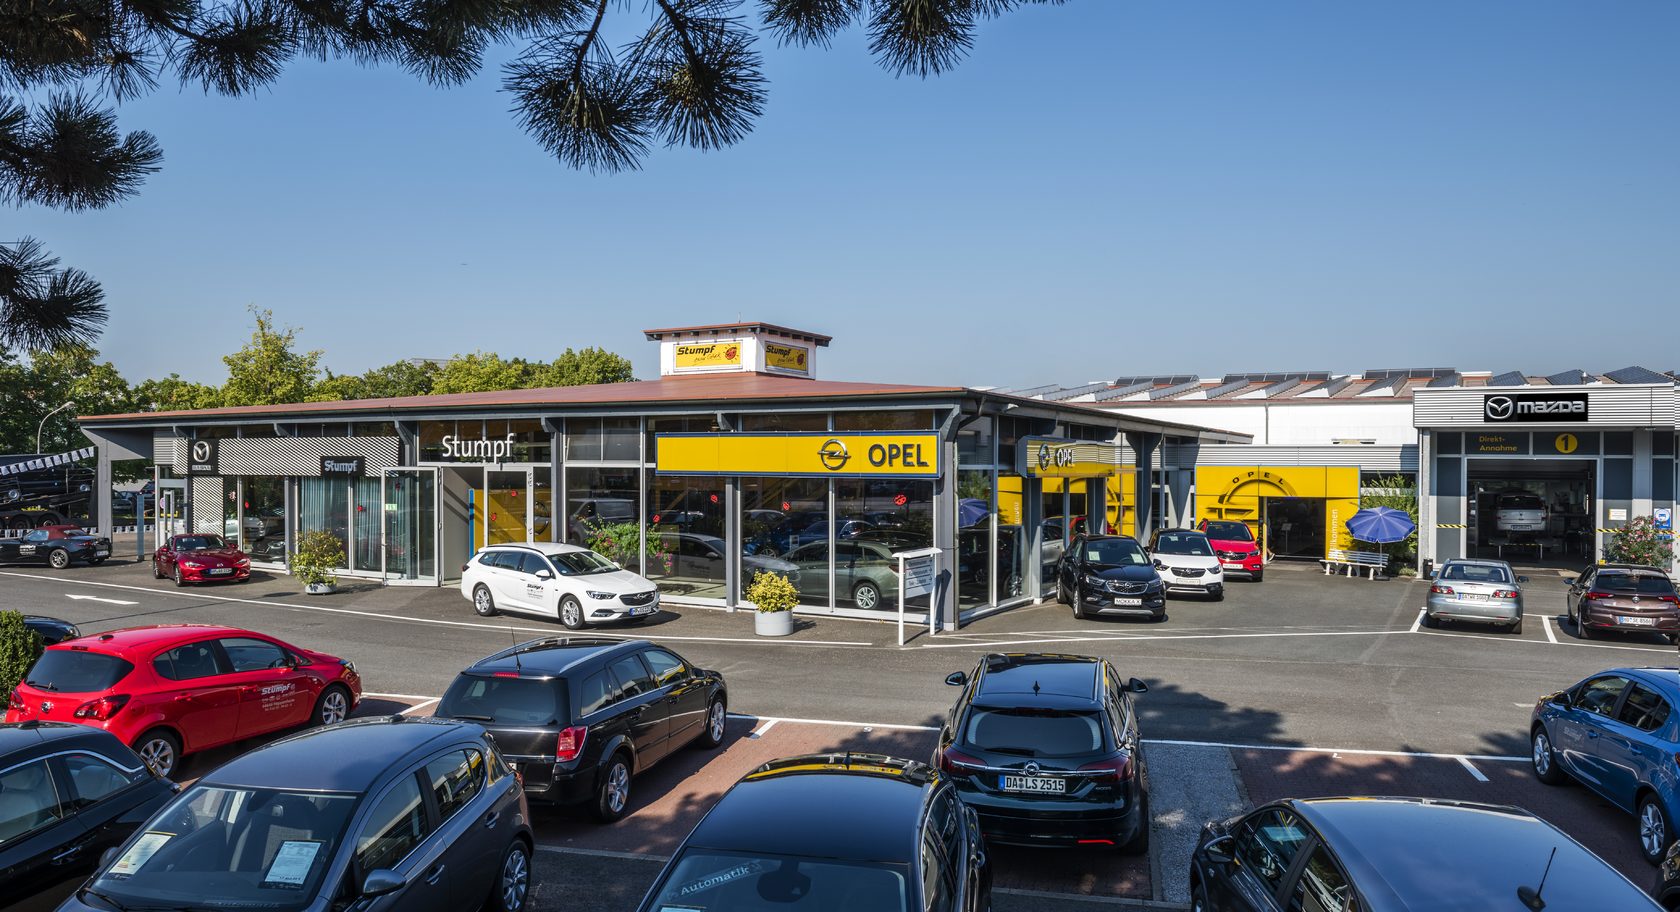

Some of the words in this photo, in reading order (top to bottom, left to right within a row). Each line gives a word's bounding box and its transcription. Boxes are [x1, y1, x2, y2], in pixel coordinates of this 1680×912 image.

[677, 345, 716, 356] Stumpf
[766, 345, 791, 357] Stumpf
[1479, 435, 1505, 443] Direkt-
[1561, 434, 1570, 451] 1
[442, 433, 515, 464] Stumpf
[868, 443, 930, 468] OPEL
[1056, 448, 1074, 467] OPEL
[324, 459, 358, 474] Stumpf
[1232, 471, 1285, 485] OPEL
[261, 683, 292, 695] Stumpf
[1006, 777, 1018, 789] DA
[1025, 778, 1038, 790] LS
[1040, 779, 1065, 791] 2515
[681, 865, 750, 896] Automatik
